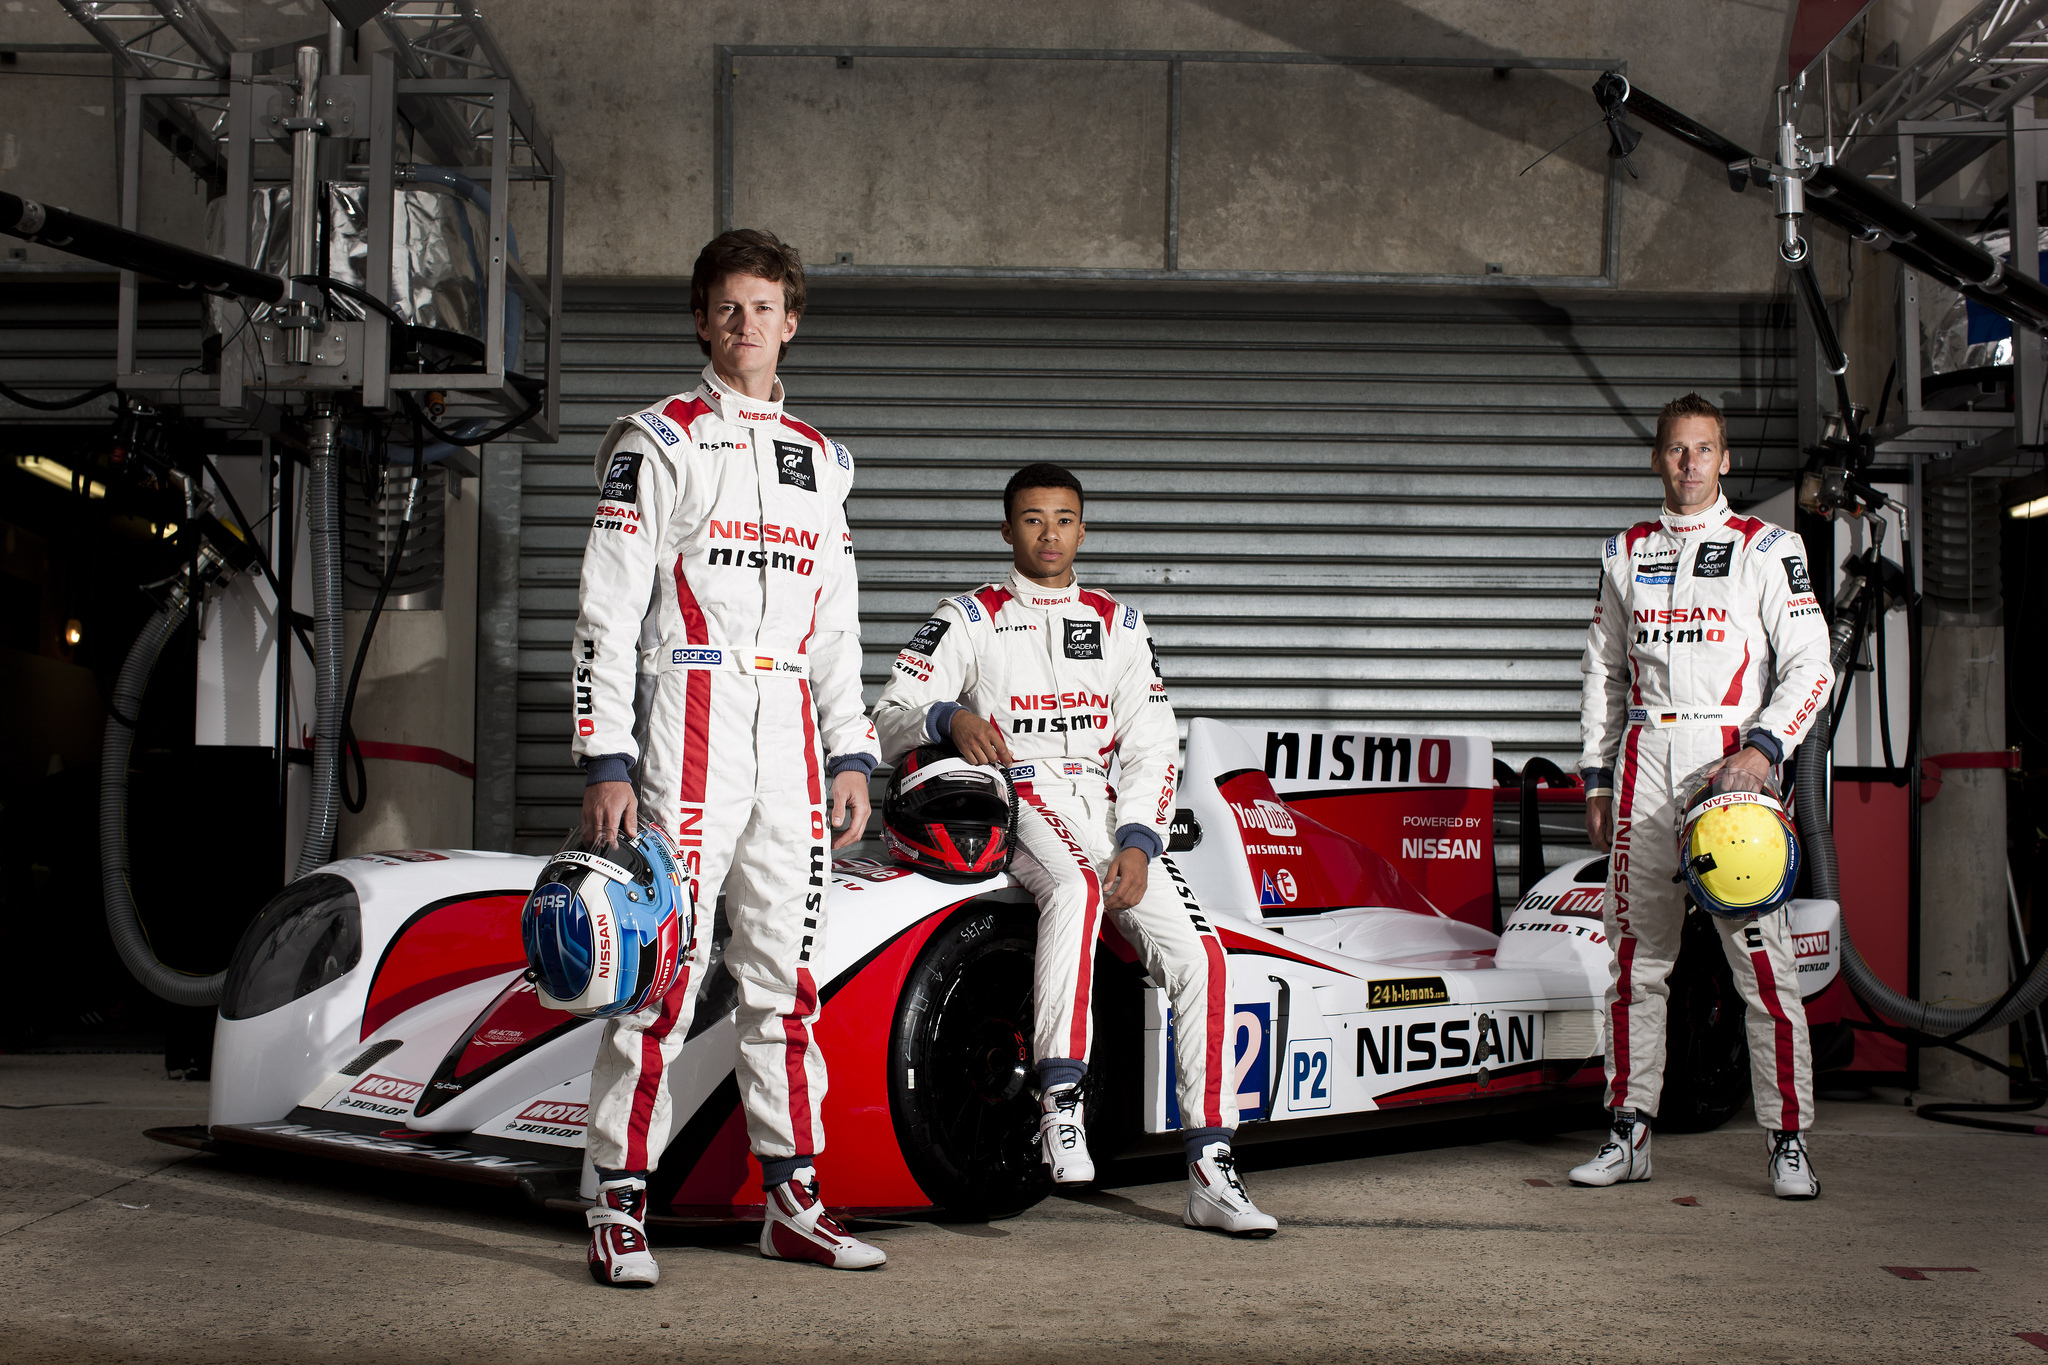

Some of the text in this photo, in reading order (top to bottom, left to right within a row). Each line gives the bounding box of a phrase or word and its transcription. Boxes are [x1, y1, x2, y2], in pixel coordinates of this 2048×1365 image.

[738, 409, 778, 421] NISSAN
[643, 413, 678, 443] sparco
[782, 445, 804, 454] NISSAN
[781, 467, 811, 481] ACADEMY
[596, 505, 641, 522] SSAN
[593, 518, 638, 535] smo
[709, 519, 820, 551] NISSAN
[1670, 522, 1706, 533] NISSAN
[708, 547, 814, 577] nismo
[1633, 548, 1677, 559] nismo
[1031, 596, 1071, 606] NISSAN
[1787, 597, 1819, 609] NISSA
[1633, 607, 1727, 625] NISSAN
[1789, 607, 1821, 618] nism
[1635, 628, 1726, 645] nismo
[673, 650, 721, 662] sparco
[1066, 643, 1100, 651] ACADEMY
[775, 661, 782, 671] L.
[893, 661, 930, 683] smo
[897, 653, 935, 673] SSAN
[1010, 691, 1110, 712] NISSAN
[1783, 673, 1829, 738] NISSAN
[1012, 714, 1109, 734] nismo
[1693, 712, 1723, 720] Krumm
[1263, 730, 1452, 785] nismo
[1702, 793, 1758, 811] NISSAN
[1229, 802, 1294, 831] YouTube
[1402, 815, 1481, 829] POWERED BY
[1035, 805, 1095, 871] NISSAN
[1402, 837, 1481, 861] NISSAN
[596, 860, 623, 876] nismo
[798, 810, 825, 962] nismo
[1613, 820, 1633, 940] NISSAN
[533, 893, 567, 910] Stilo
[1514, 890, 1605, 913] YouTub
[597, 913, 611, 979] NISSAN
[1793, 933, 1829, 955] MOTUL
[1798, 961, 1830, 973] DUNLOP
[656, 958, 671, 996] nismo
[498, 1029, 524, 1037] ACTION
[1355, 1013, 1535, 1078] NISSAN
[1233, 1010, 1263, 1111] 2
[1292, 1050, 1328, 1101] P2
[349, 1099, 409, 1116] DUNLOP
[523, 1102, 589, 1123] MOTU
[516, 1123, 583, 1138] DUNLOP
[252, 1124, 540, 1168] NISSAN
